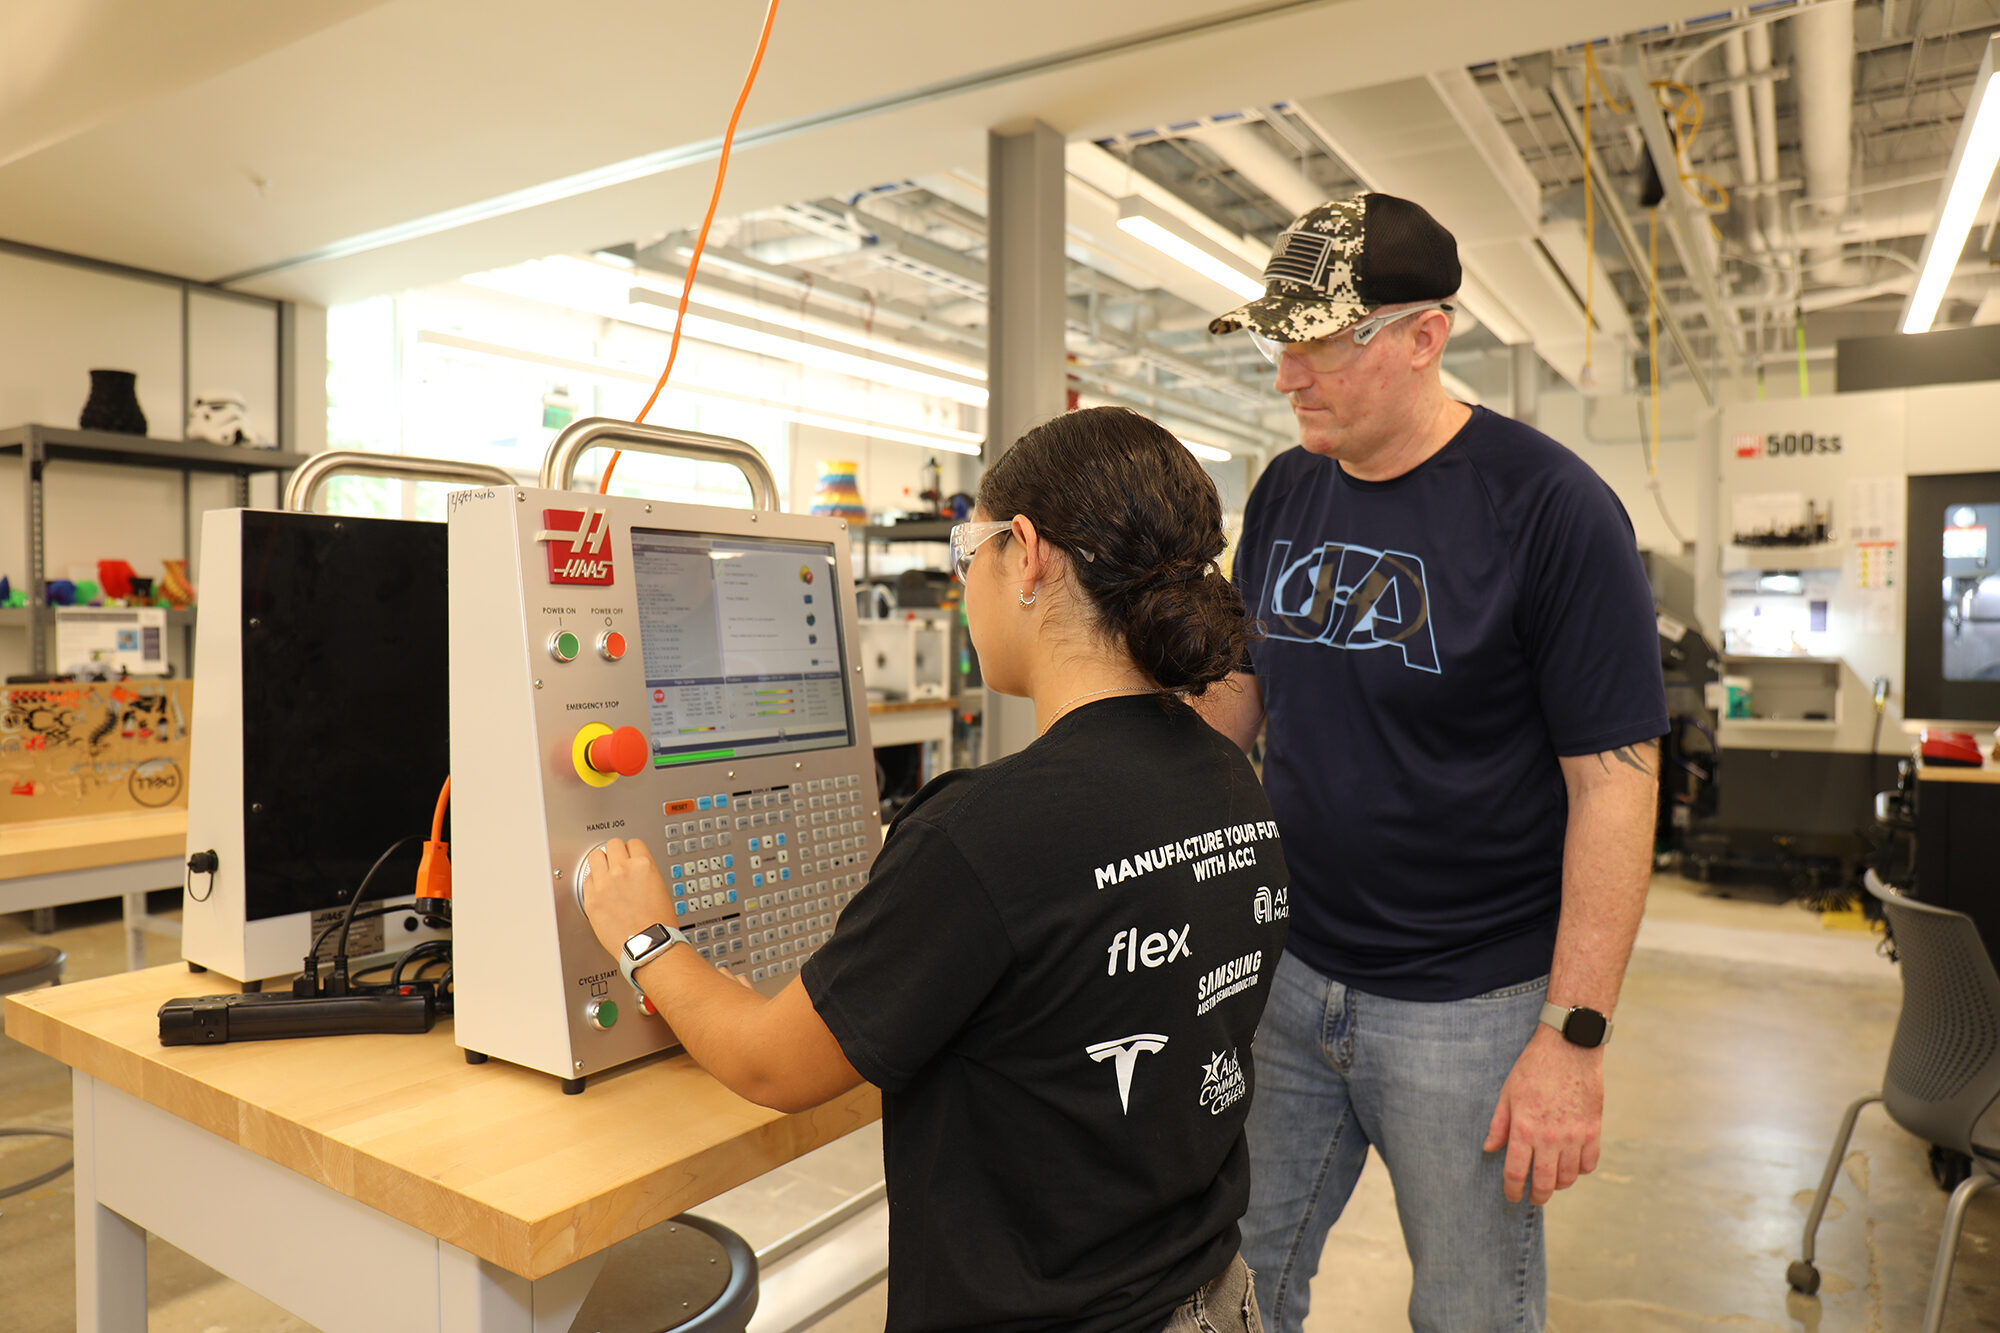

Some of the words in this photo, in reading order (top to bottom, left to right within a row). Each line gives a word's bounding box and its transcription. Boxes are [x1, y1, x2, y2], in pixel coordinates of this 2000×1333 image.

[553, 558, 614, 580] HAAS
[566, 702, 603, 711] EMERGENCY
[605, 701, 620, 709] STOP
[671, 803, 689, 811] RESET
[586, 821, 610, 831] HANDLE
[612, 819, 625, 828] JOG
[1094, 829, 1225, 889] MANUFACTURE
[1223, 823, 1258, 846] YOUR
[1192, 854, 1226, 882] WITH
[1228, 846, 1257, 870] ACC!
[1107, 923, 1191, 977] flex
[578, 974, 600, 986] CYCLE
[600, 969, 618, 981] START
[1197, 950, 1262, 1000] SAMSUNG
[1196, 994, 1217, 1017] AUSTIN
[1216, 974, 1259, 1003] SEMICONDUCTOR
